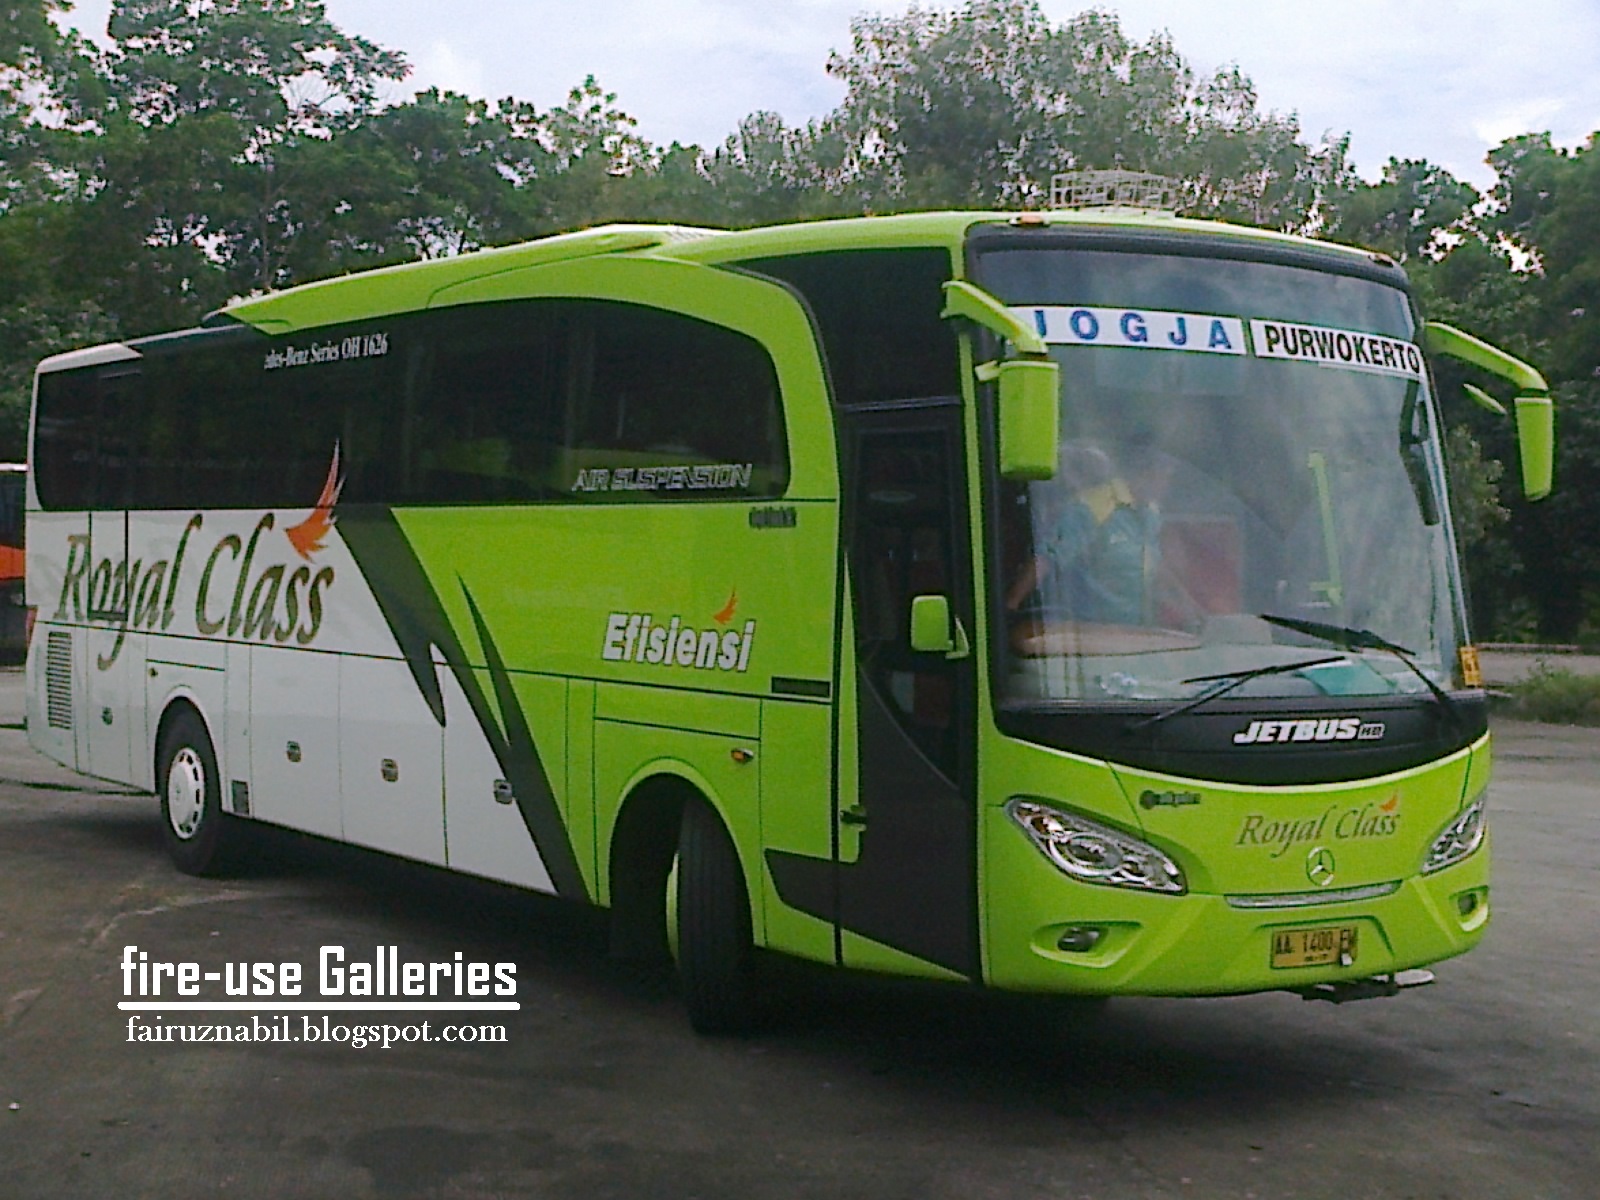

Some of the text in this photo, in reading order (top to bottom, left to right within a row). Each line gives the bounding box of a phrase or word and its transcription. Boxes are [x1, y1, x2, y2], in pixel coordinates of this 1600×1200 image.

[310, 341, 340, 363] Series
[341, 335, 362, 359] OH
[363, 332, 389, 356] 1626
[1033, 309, 1232, 350] JOGJA
[1265, 325, 1421, 374] PURWOKERTO
[571, 464, 752, 491] AIR SUSPENSION
[53, 512, 335, 671] Royal Class
[602, 611, 756, 673] Efisiensi
[1233, 718, 1360, 745] JETBUS
[1236, 802, 1401, 859] Royal Class
[1275, 934, 1293, 955] AA
